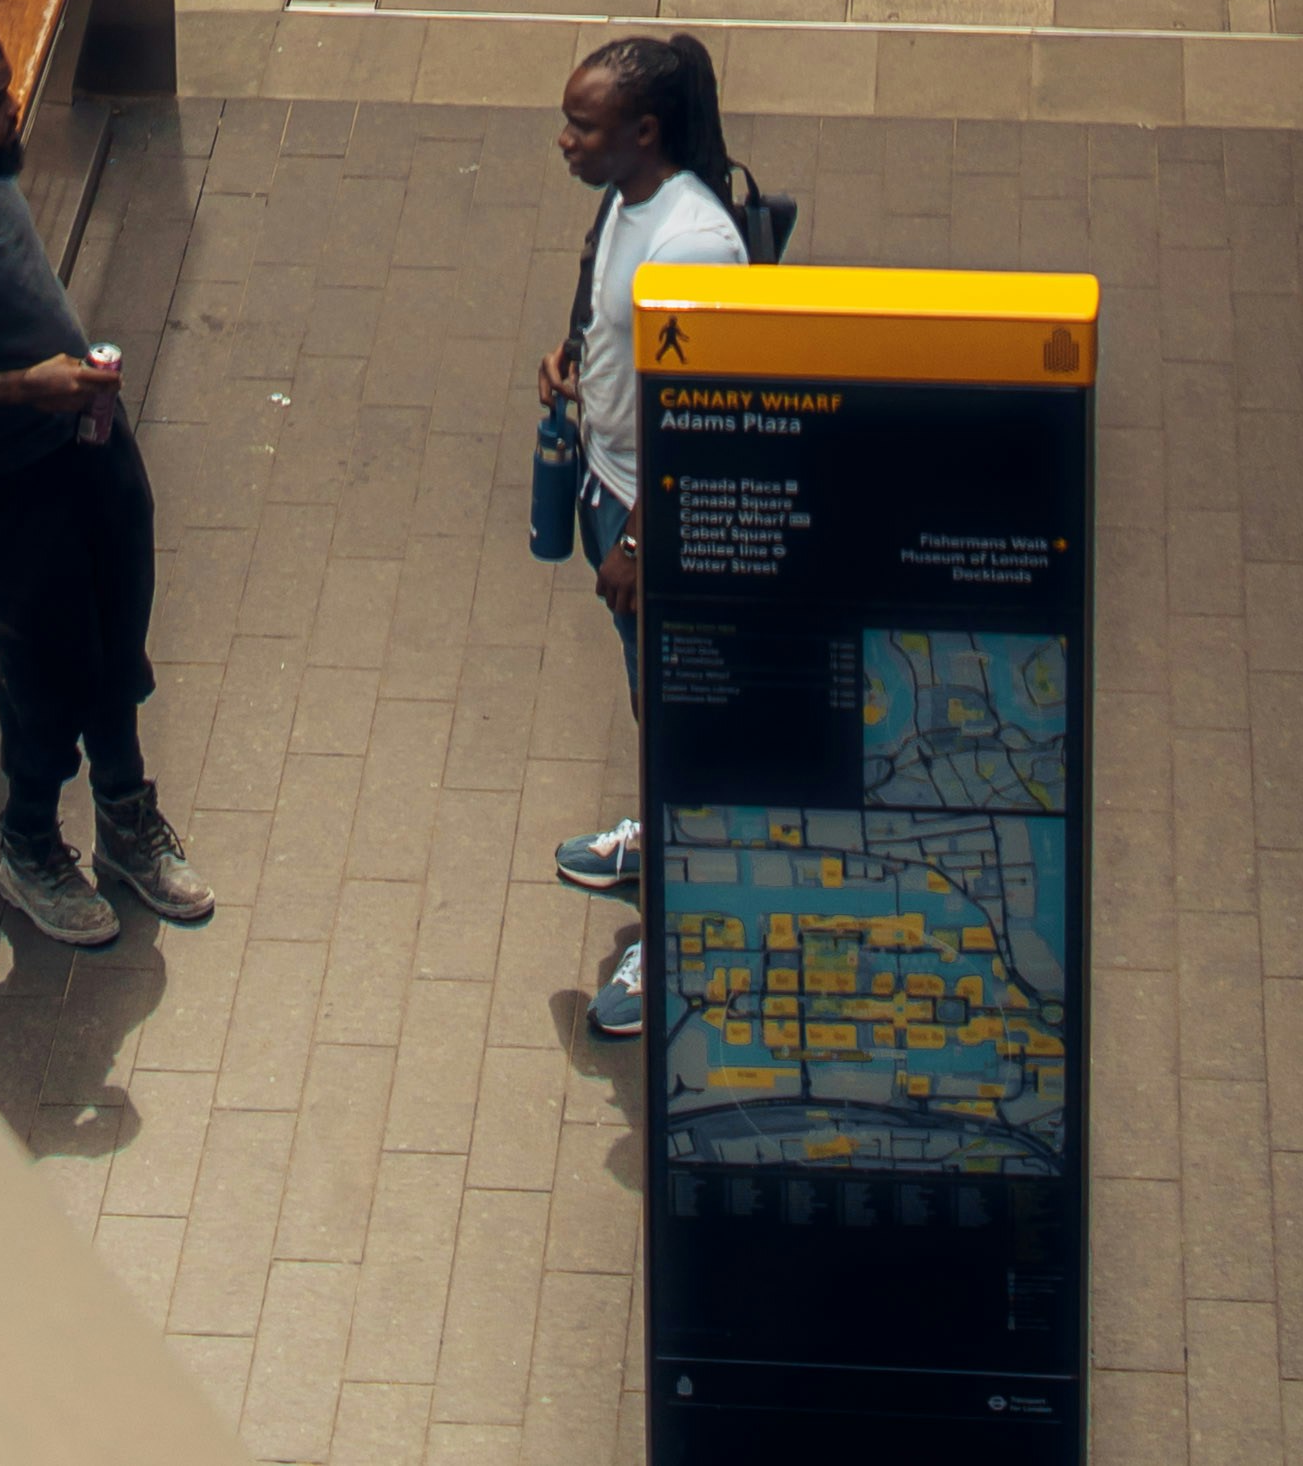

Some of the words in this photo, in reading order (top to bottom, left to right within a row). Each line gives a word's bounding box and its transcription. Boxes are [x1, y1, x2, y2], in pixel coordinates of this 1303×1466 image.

[659, 387, 753, 410] CANARY
[760, 391, 843, 413] WHARF
[660, 409, 736, 431] Adams
[743, 412, 801, 434] Plaza
[679, 475, 736, 491] Canada
[740, 478, 781, 494] Place
[679, 492, 736, 508] Canada
[741, 494, 792, 512] Square
[679, 508, 733, 527] Canary
[738, 510, 786, 526] Wharf
[679, 524, 726, 540] Cabot
[731, 526, 783, 544] Square
[920, 532, 1007, 550] Fishermans
[1010, 535, 1048, 551] Walk
[680, 541, 735, 557] Jubilee
[739, 543, 768, 557] line
[900, 548, 966, 565] Museum
[969, 549, 988, 565] of
[990, 551, 1048, 568] London
[680, 556, 727, 572] Water
[730, 558, 778, 574] Street
[952, 566, 1032, 583] Docklands
